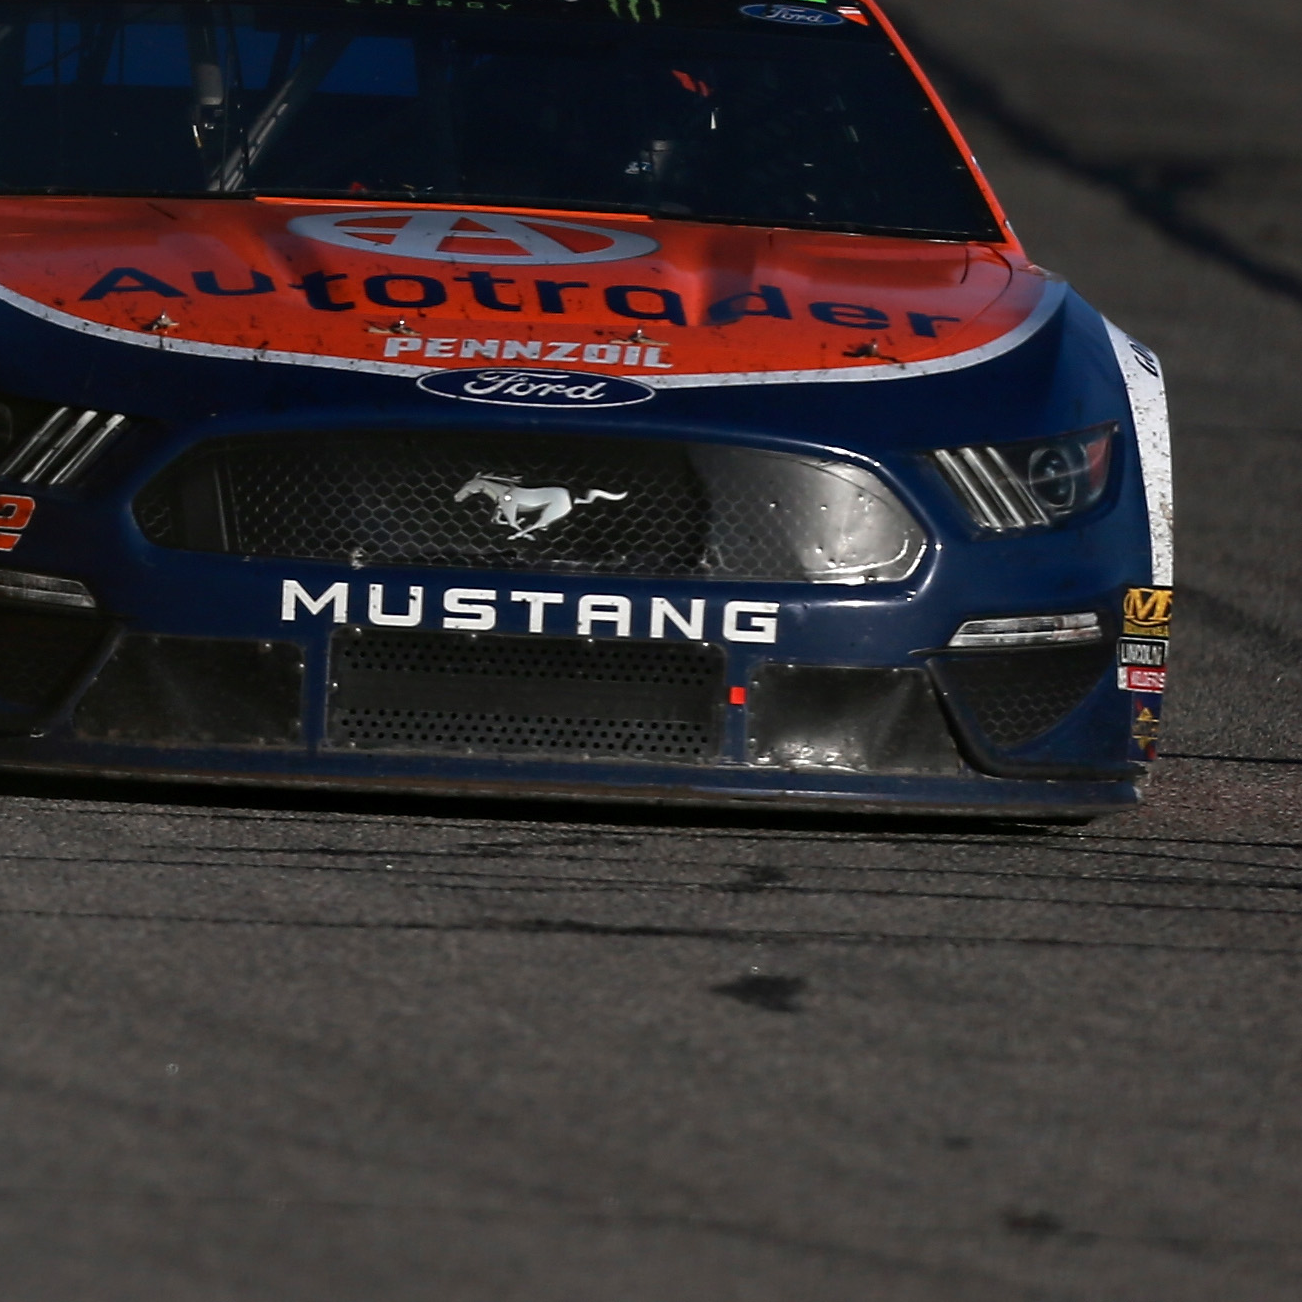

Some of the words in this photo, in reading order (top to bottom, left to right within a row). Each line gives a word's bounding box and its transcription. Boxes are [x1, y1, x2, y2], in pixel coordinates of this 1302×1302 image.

[80, 266, 961, 339] Autotrader
[383, 337, 674, 369] PENNZOIL
[463, 370, 607, 400] Ford
[281, 579, 780, 643] MUSTANG
